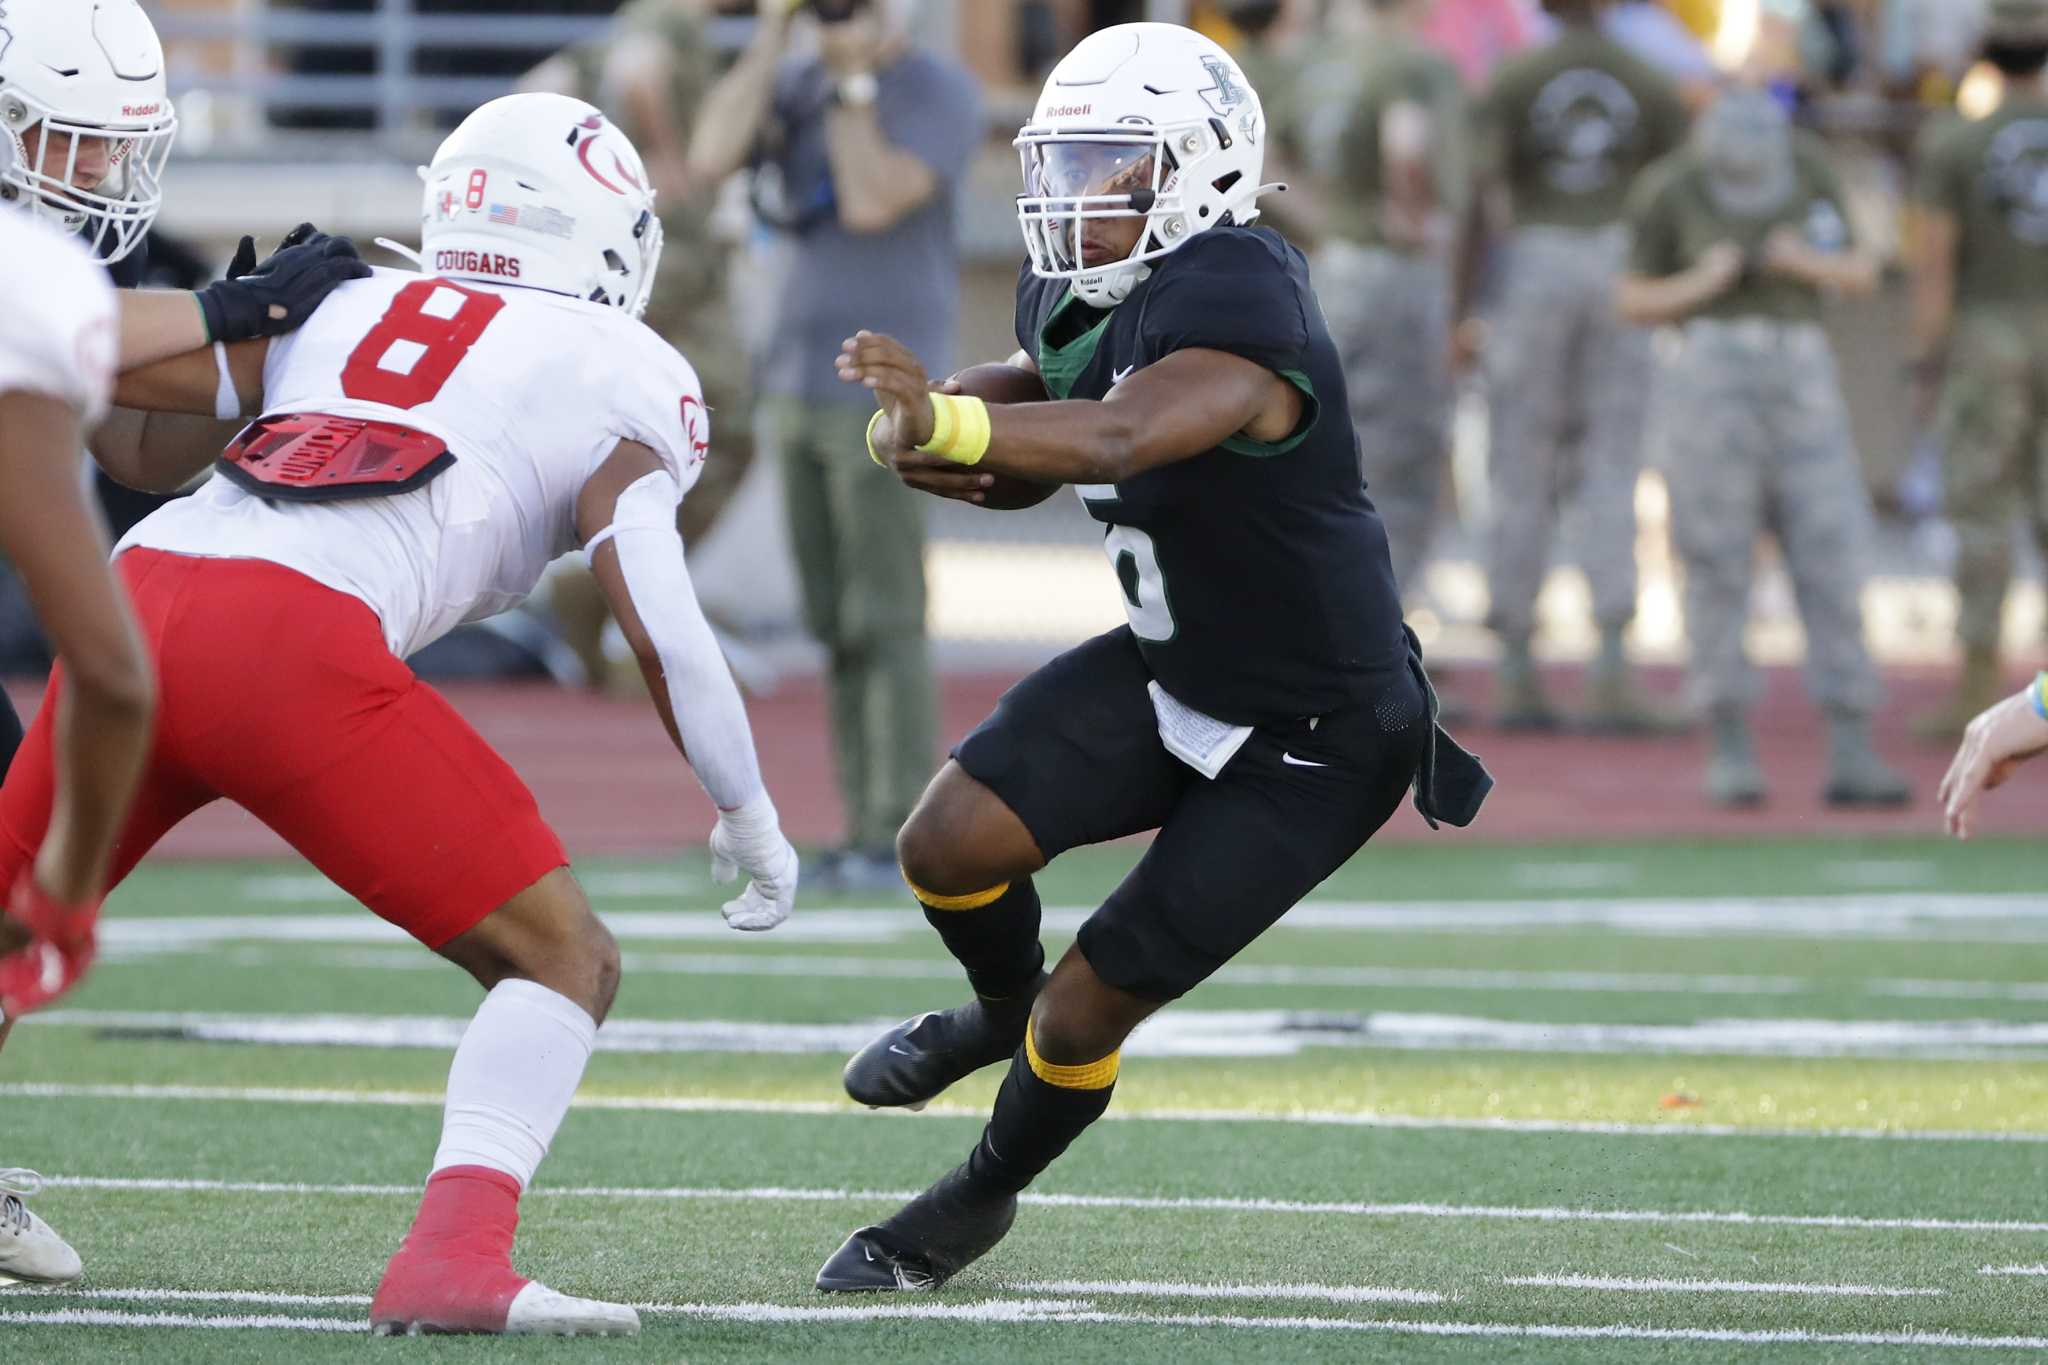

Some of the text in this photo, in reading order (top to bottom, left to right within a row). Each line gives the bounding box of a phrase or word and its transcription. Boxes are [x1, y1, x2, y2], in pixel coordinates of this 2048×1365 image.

[122, 103, 160, 116] Riddell
[1046, 104, 1091, 118] Riddell
[466, 168, 487, 209] 8
[436, 250, 521, 278] COUGARS
[340, 276, 507, 411] 8
